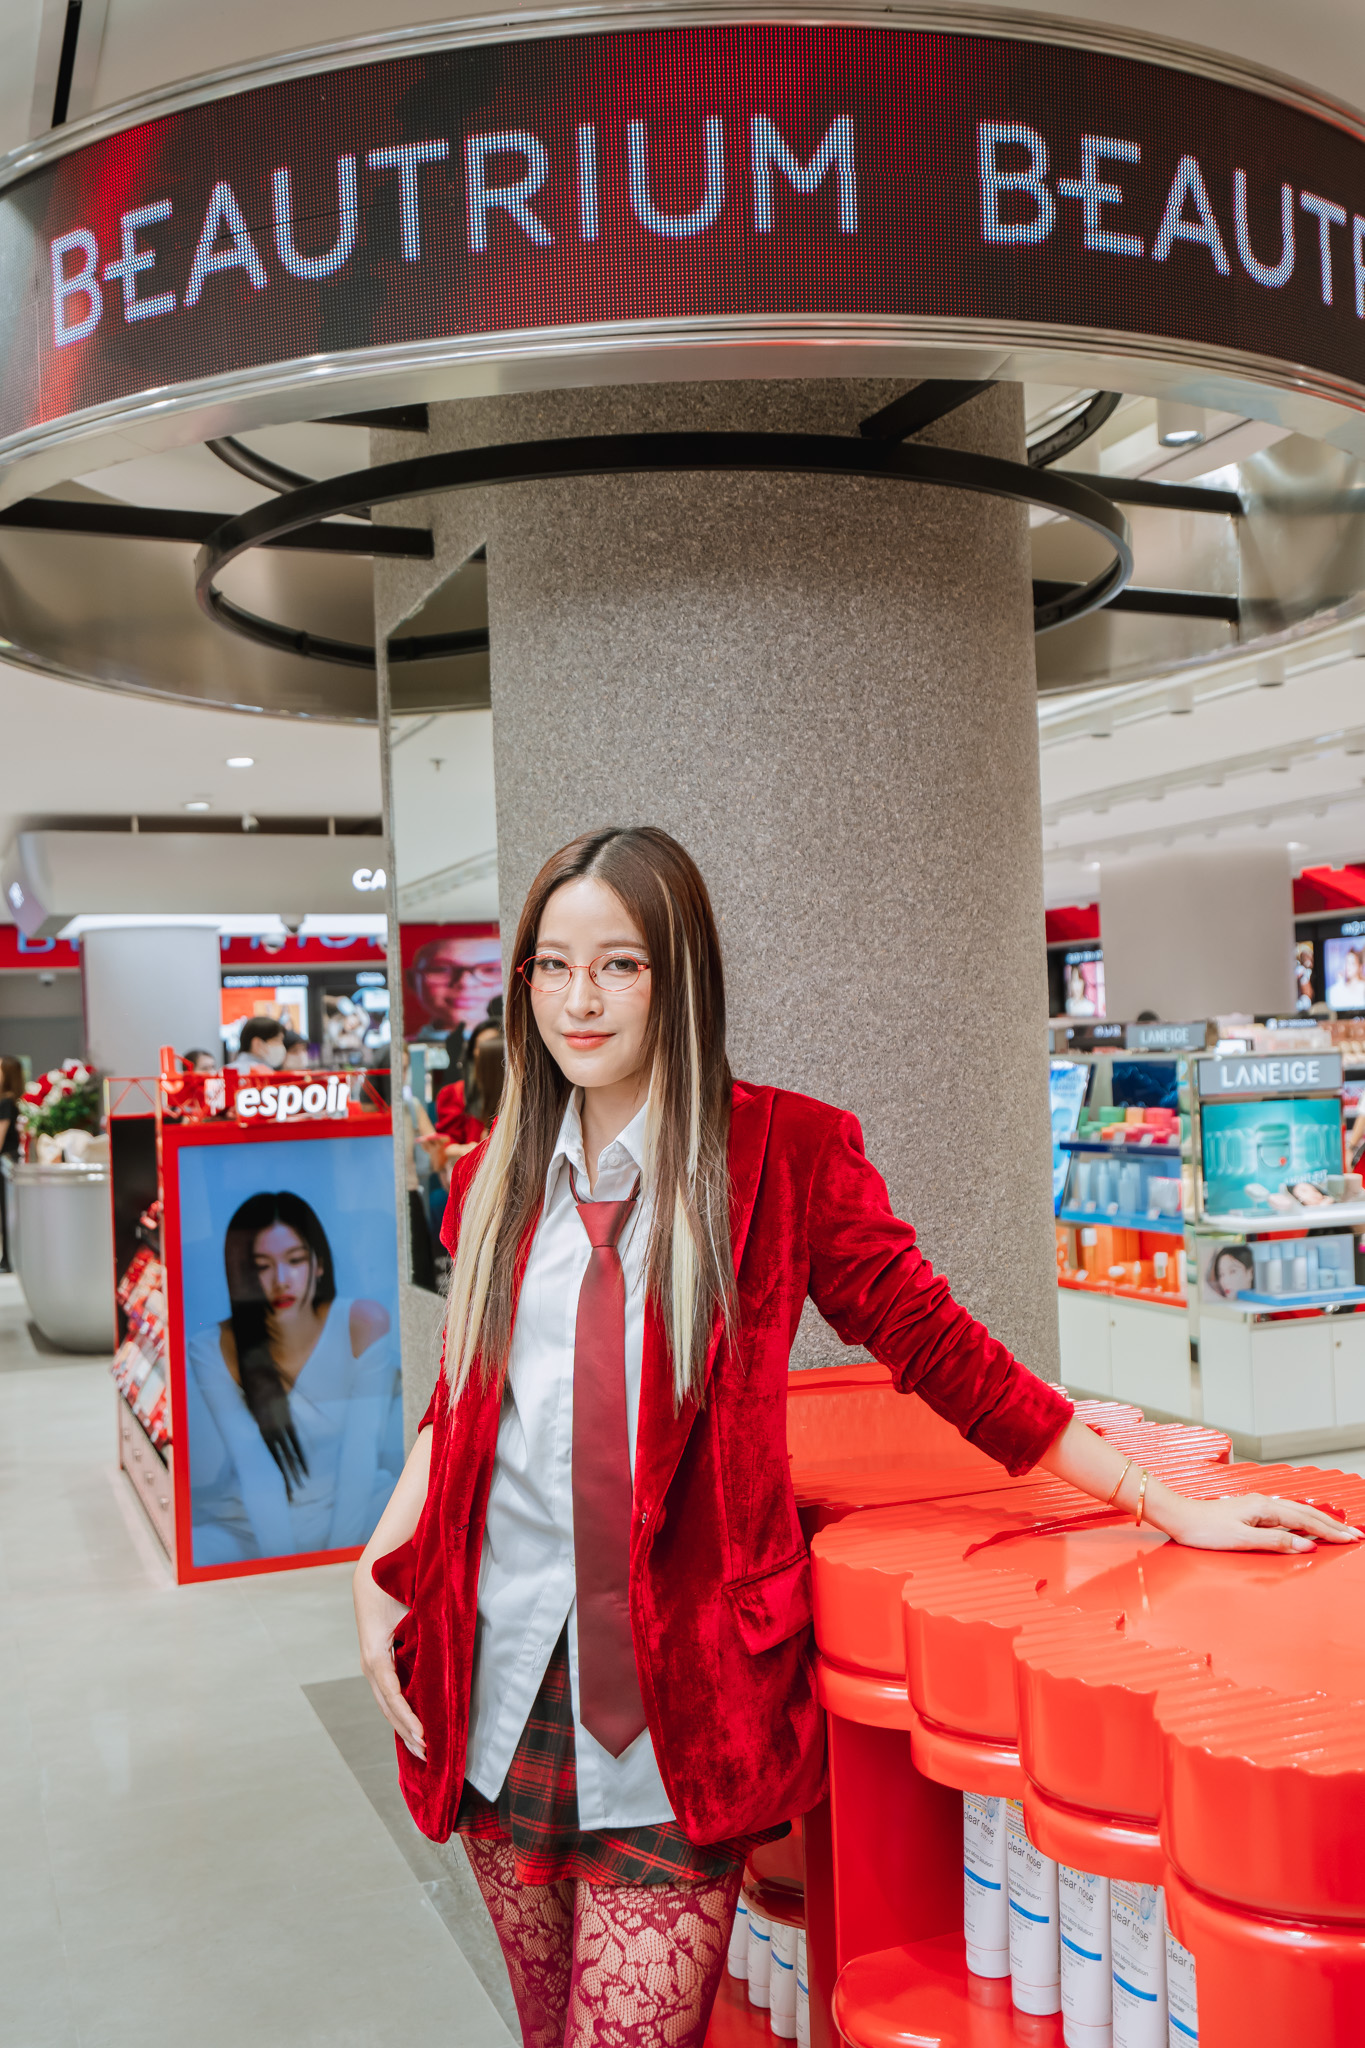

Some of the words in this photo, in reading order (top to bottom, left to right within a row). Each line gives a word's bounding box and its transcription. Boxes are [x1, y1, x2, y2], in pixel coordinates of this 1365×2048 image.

[50, 112, 858, 348] BEAUTRIUM
[1140, 1027, 1189, 1044] LANEIGE
[1220, 1060, 1321, 1088] LANEIGE
[236, 1075, 350, 1122] espoir
[964, 1811, 980, 1827] clear
[981, 1822, 995, 1838] nose
[1007, 1841, 1025, 1857] clear
[1026, 1852, 1042, 1870] nose
[1059, 1873, 1077, 1890] clear
[1078, 1886, 1094, 1904] nose
[1111, 1908, 1131, 1927] clear
[1132, 1923, 1149, 1942] nose
[1167, 1948, 1188, 1968] clear
